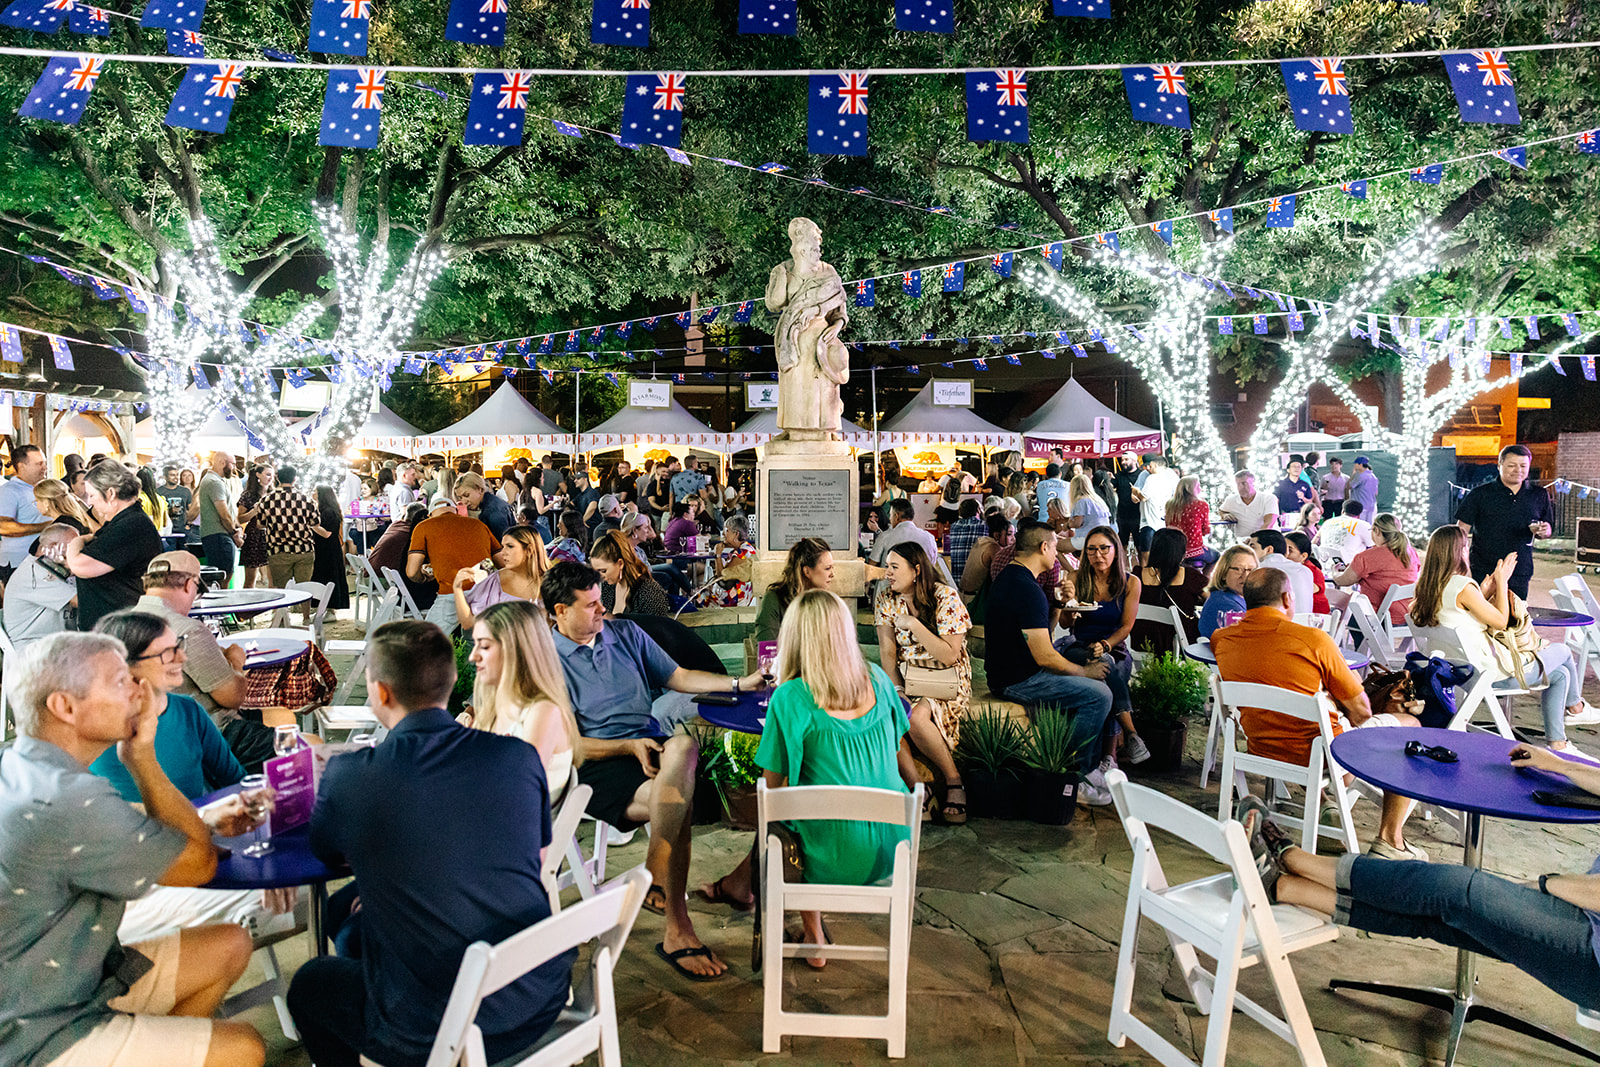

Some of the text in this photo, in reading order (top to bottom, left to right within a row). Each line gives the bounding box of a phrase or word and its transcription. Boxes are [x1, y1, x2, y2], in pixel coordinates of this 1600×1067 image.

[1031, 442, 1071, 453] WINES
[1075, 445, 1092, 453] BY
[1120, 439, 1159, 451] GLASS
